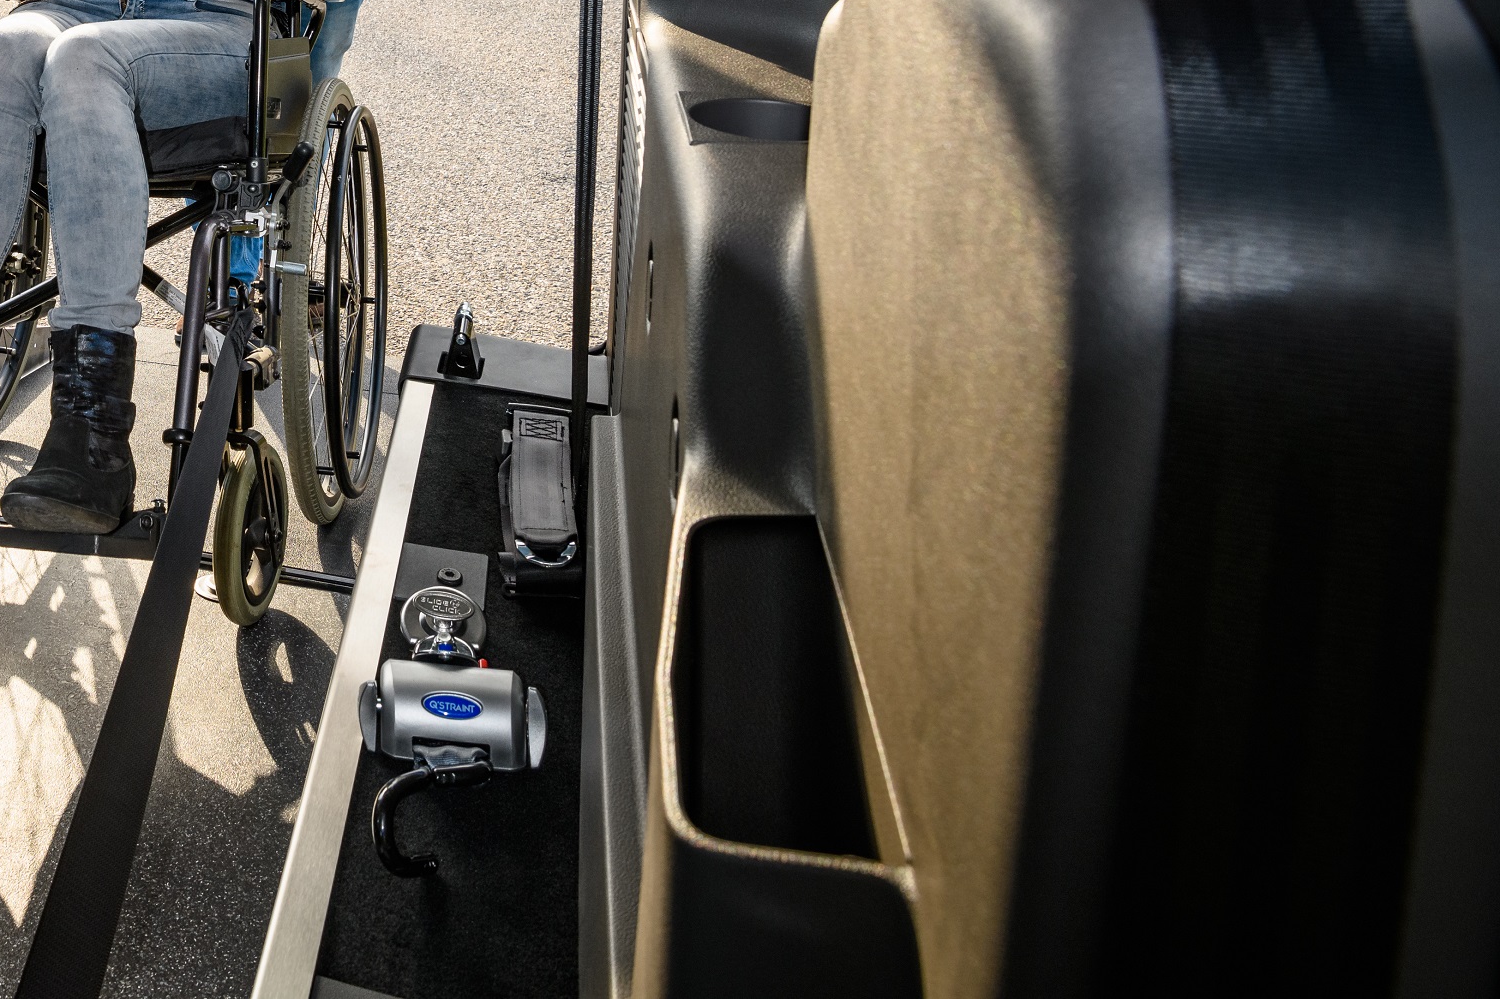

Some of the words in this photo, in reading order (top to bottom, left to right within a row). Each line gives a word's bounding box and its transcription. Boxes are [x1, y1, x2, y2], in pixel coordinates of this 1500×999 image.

[420, 596, 449, 607] SLIDE
[432, 604, 461, 615] CLICK
[429, 700, 476, 714] Q'STRAINT
